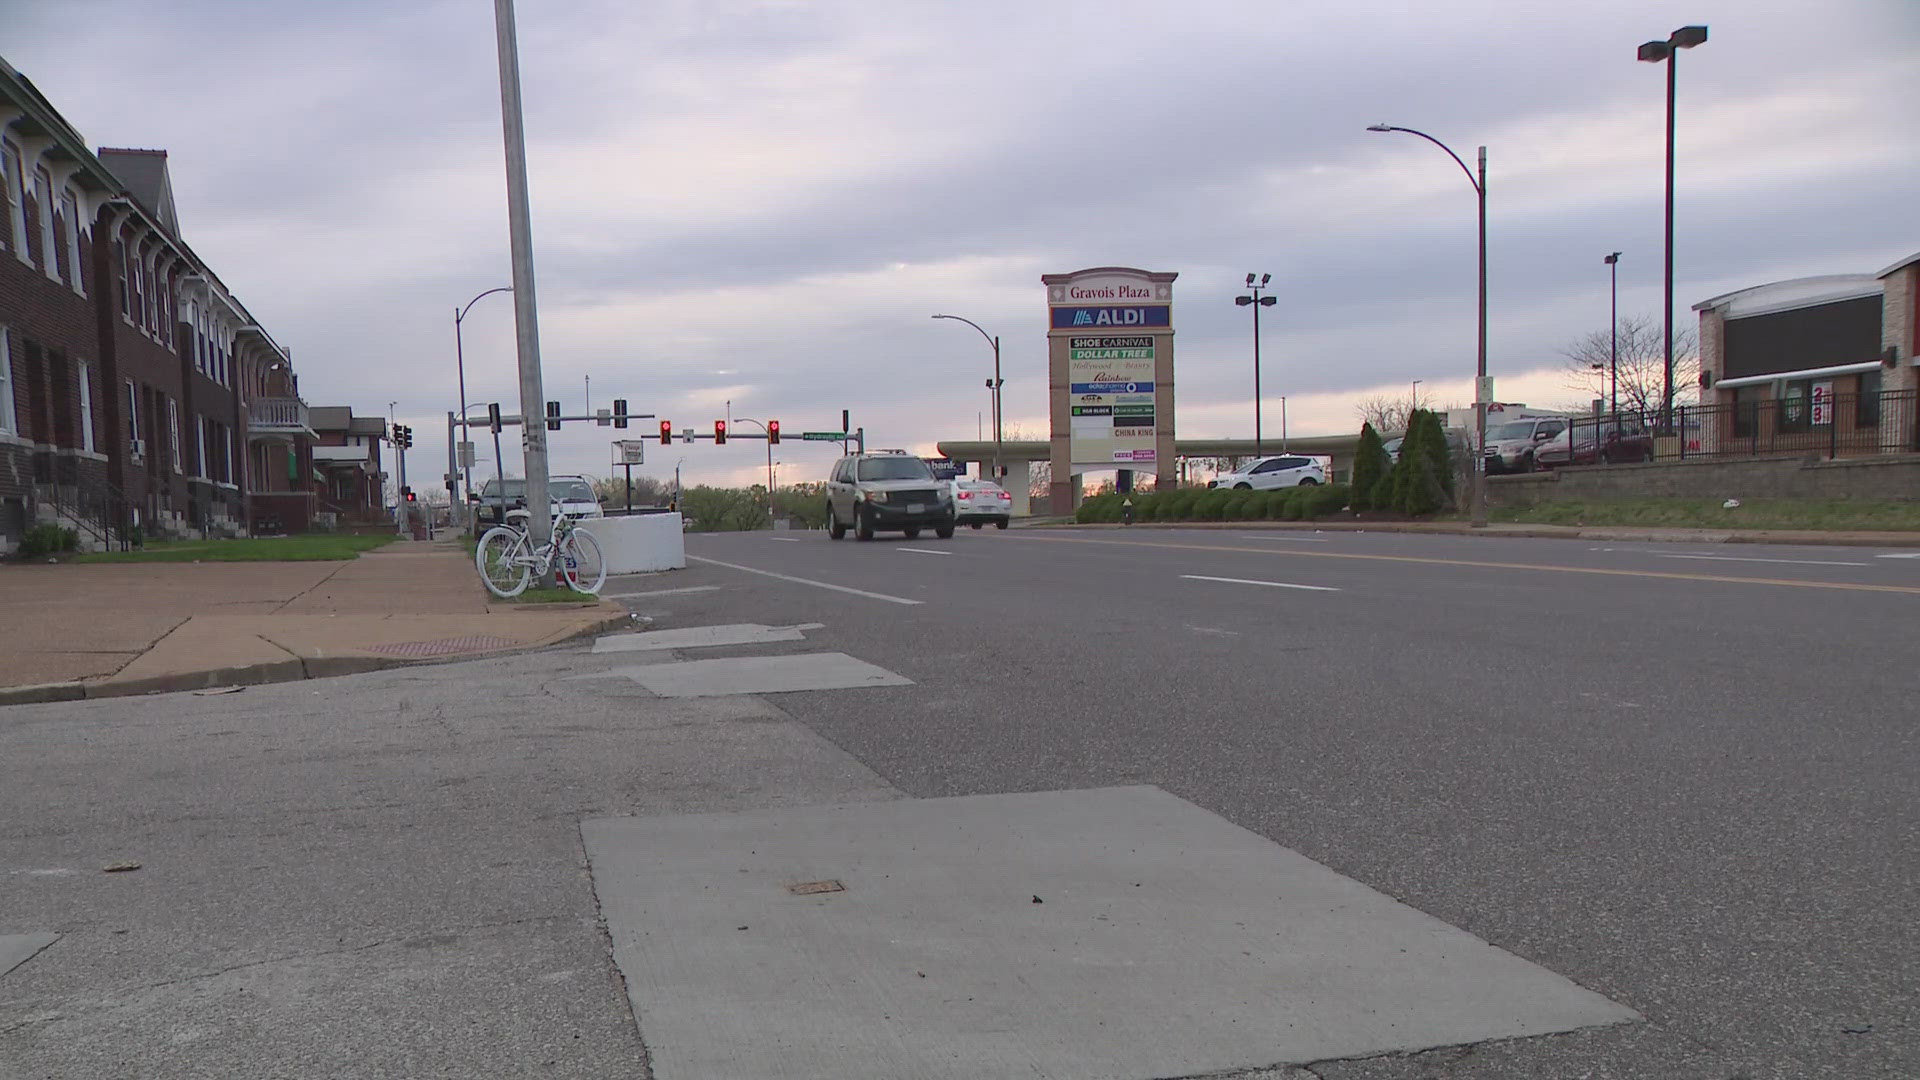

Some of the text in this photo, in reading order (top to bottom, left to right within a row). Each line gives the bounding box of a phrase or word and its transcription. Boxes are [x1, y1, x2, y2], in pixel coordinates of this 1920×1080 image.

[1070, 285, 1150, 299] Gravois Plaza
[1096, 309, 1145, 325] ALDI
[1074, 338, 1150, 347] SHOE CARNIVAL
[1077, 349, 1148, 359] DOLLAR TREE
[1114, 429, 1154, 437] CHINA KING
